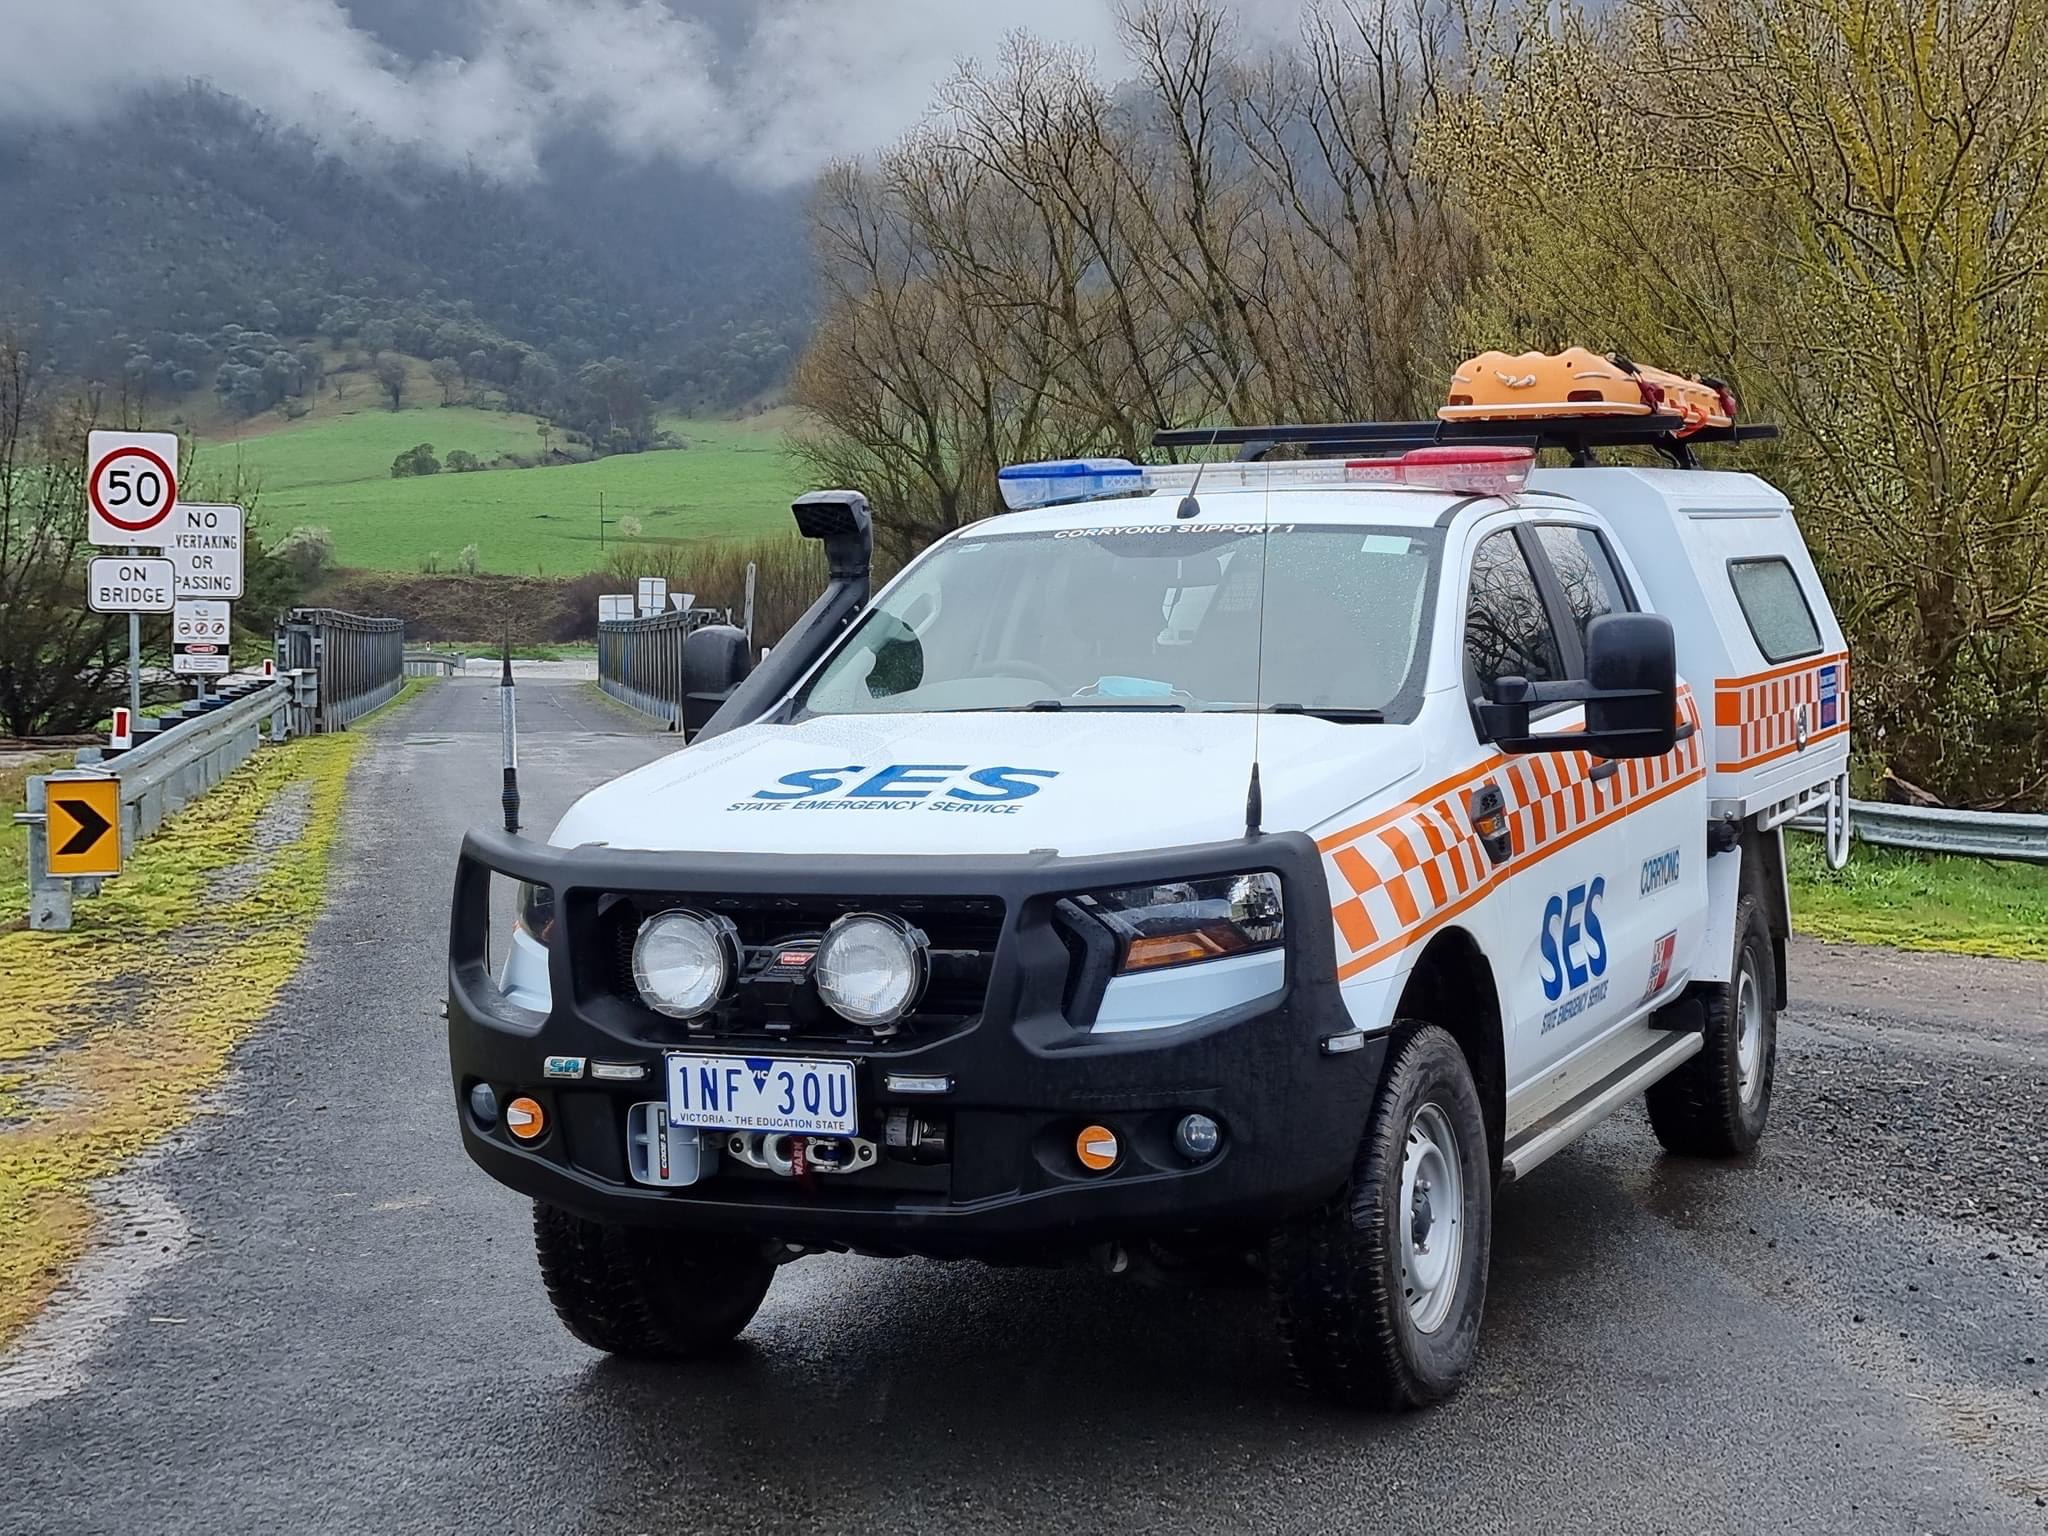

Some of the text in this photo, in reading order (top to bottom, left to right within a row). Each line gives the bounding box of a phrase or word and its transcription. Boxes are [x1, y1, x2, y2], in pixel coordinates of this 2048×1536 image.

[108, 470, 161, 507] 50
[187, 512, 217, 528] NO
[1054, 525, 1172, 540] CORRYONG
[1176, 524, 1280, 534] SUPPORT
[175, 534, 238, 549] VERTAKING
[192, 555, 213, 569] OR
[119, 567, 147, 582] ON
[175, 576, 232, 590] PASSING
[100, 588, 165, 603] BRIDGE
[752, 764, 1060, 800] SES
[726, 800, 1023, 815] STATE EMERGENCY SERVICE
[1640, 850, 1680, 896] CORRYONG
[1541, 876, 1608, 1001] SES
[752, 1070, 769, 1080] VIC
[679, 1067, 847, 1117] 1NF 3QU
[680, 1112, 724, 1124] VICTORIA
[735, 1116, 753, 1126] THE
[757, 1117, 812, 1129] EDUCATION
[815, 1120, 845, 1130] STATE
[792, 1140, 805, 1176] WARN
